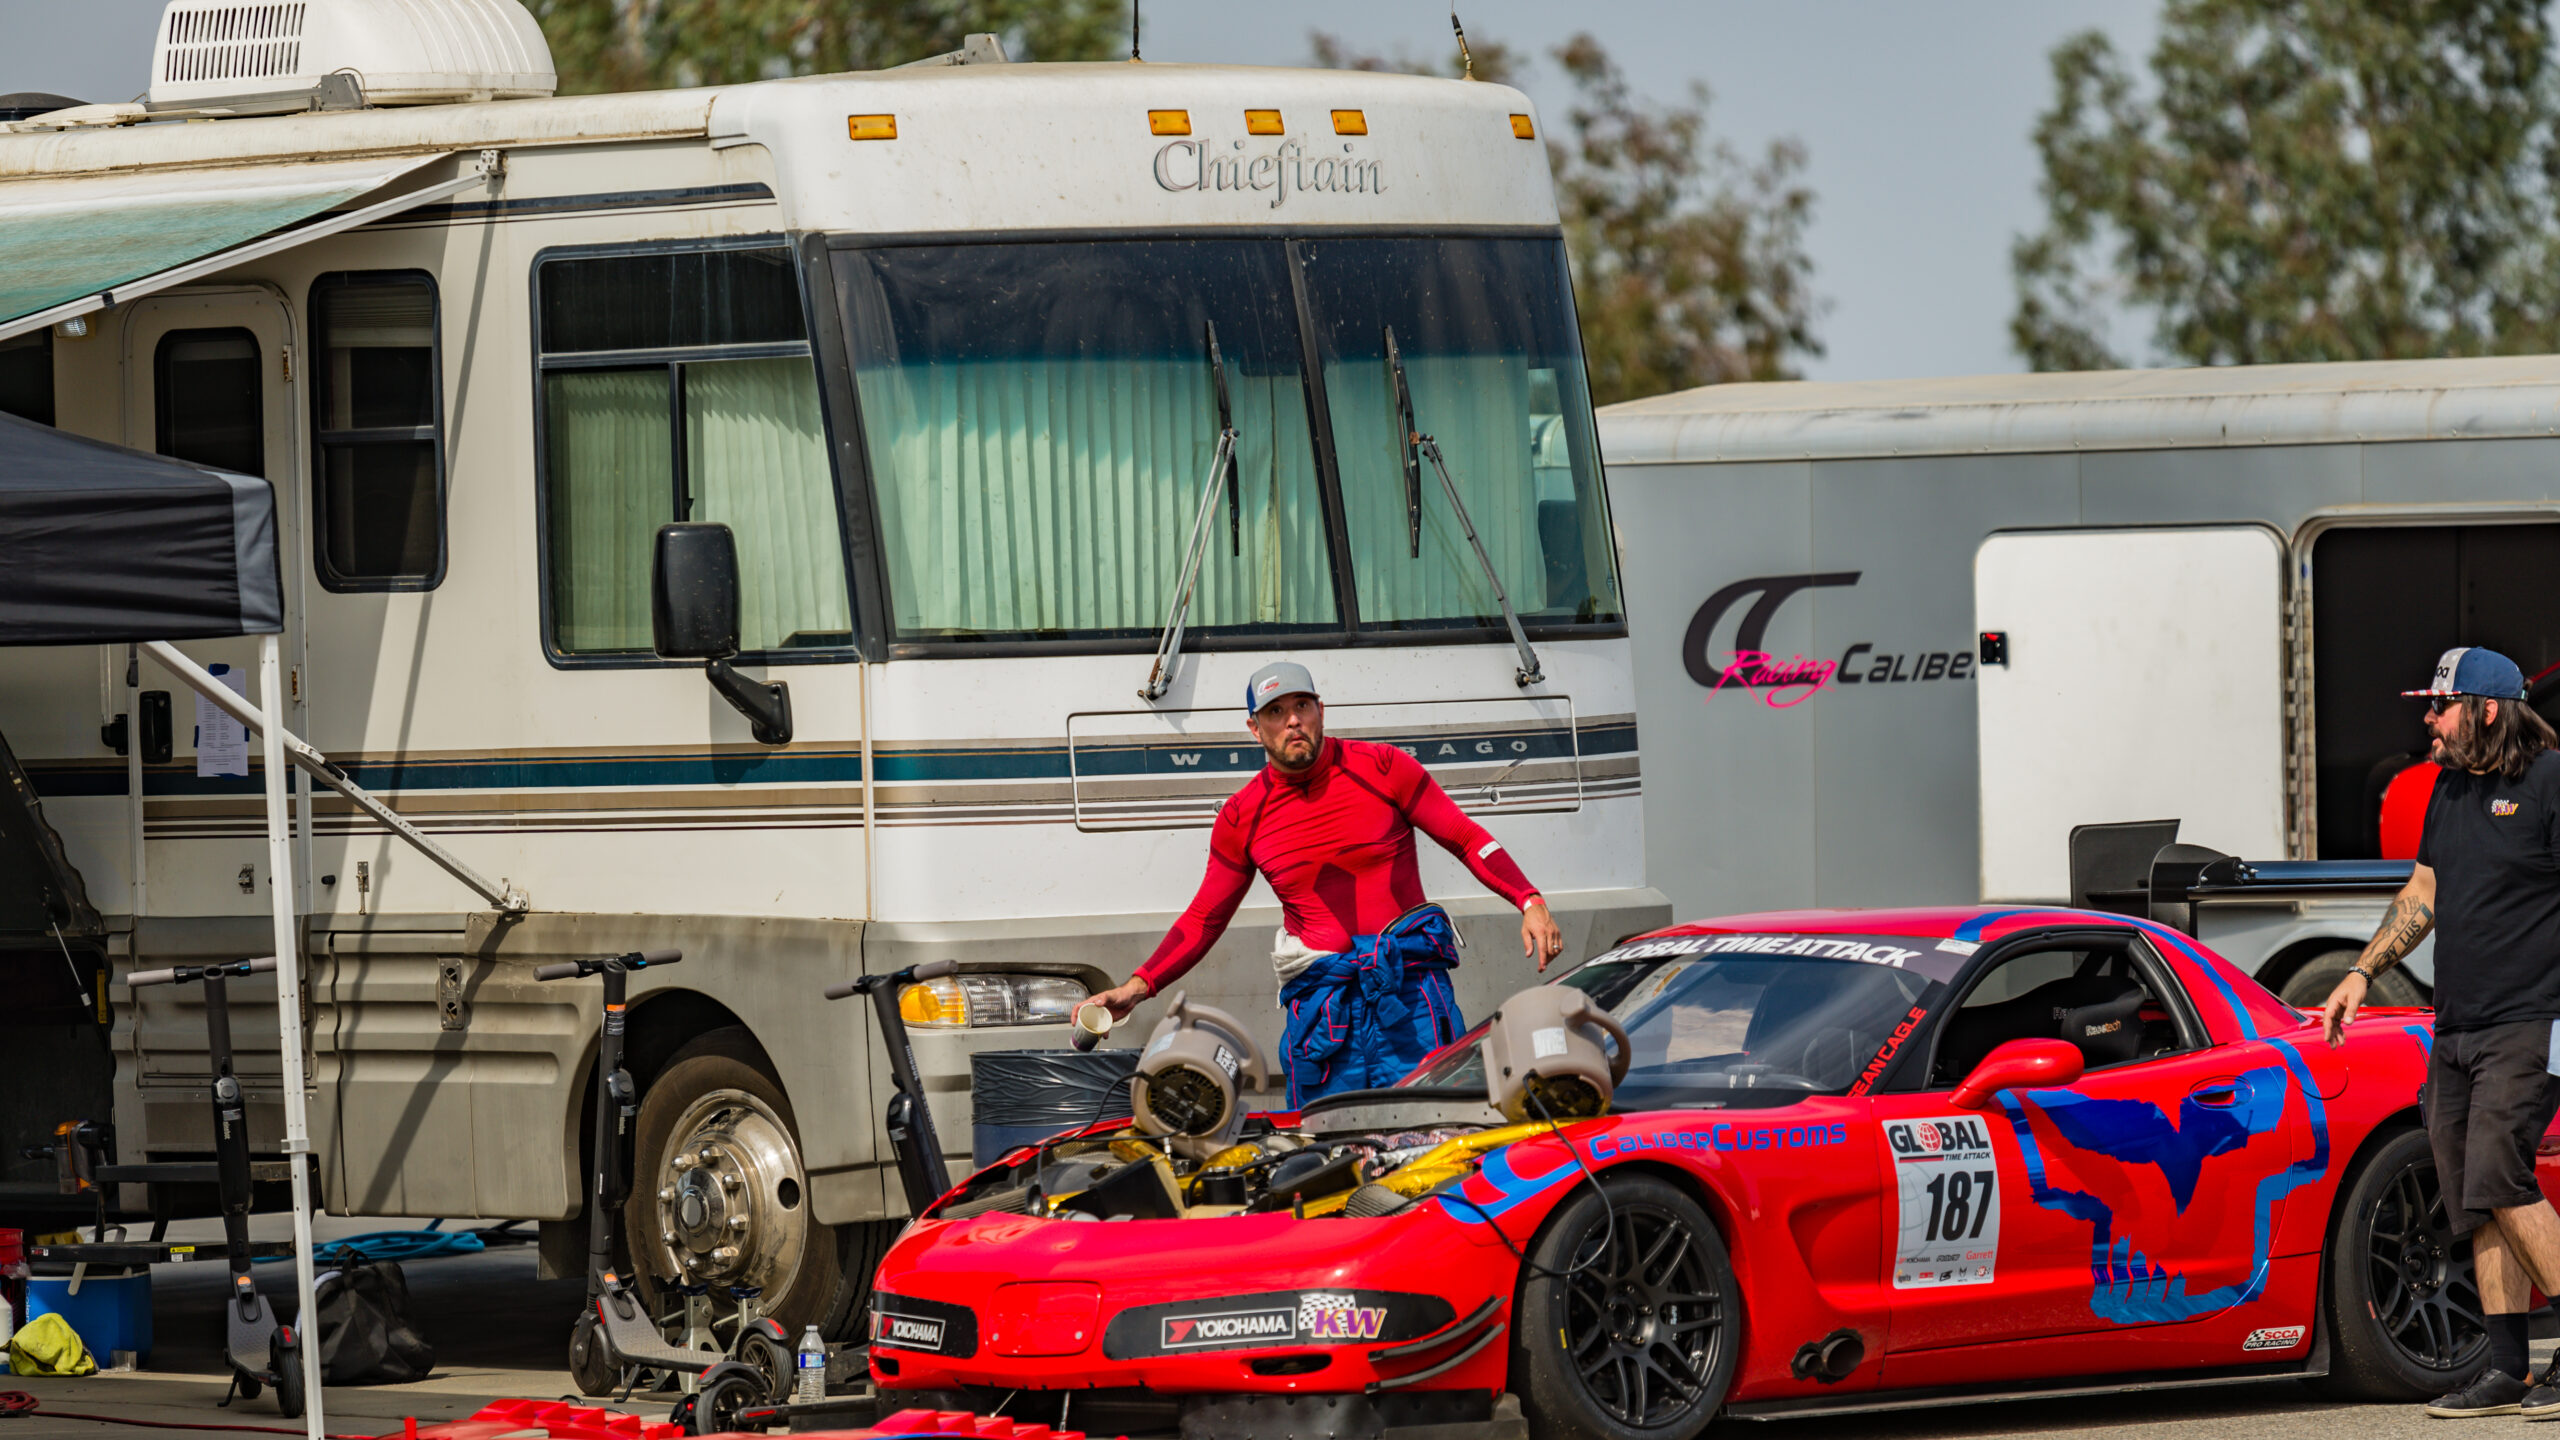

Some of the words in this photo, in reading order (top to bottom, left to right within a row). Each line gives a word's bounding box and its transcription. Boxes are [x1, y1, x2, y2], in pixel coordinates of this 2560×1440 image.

[1153, 136, 1388, 209] Chieftain
[1705, 650, 1838, 708] Racing
[1837, 643, 1976, 683] Calibe
[1168, 740, 1528, 766] WIBAGO
[1586, 939, 1707, 967] GLOBAL
[1703, 936, 1795, 953] TIME
[1785, 938, 1923, 968] ATTACK
[1877, 1006, 1927, 1061] CAGLE
[1889, 1120, 1989, 1153] GLOBAL
[1945, 1153, 1962, 1161] TIME
[1963, 1151, 1991, 1160] ATTACK
[1925, 1170, 1994, 1241] 187
[1965, 1250, 1994, 1261] Garrett
[892, 1320, 939, 1343] YOKOHAMA
[1195, 1314, 1287, 1338] YOKOHAMA
[1311, 1307, 1388, 1339] KW
[2263, 1329, 2299, 1340] SCCA
[2263, 1338, 2297, 1347] RACING
